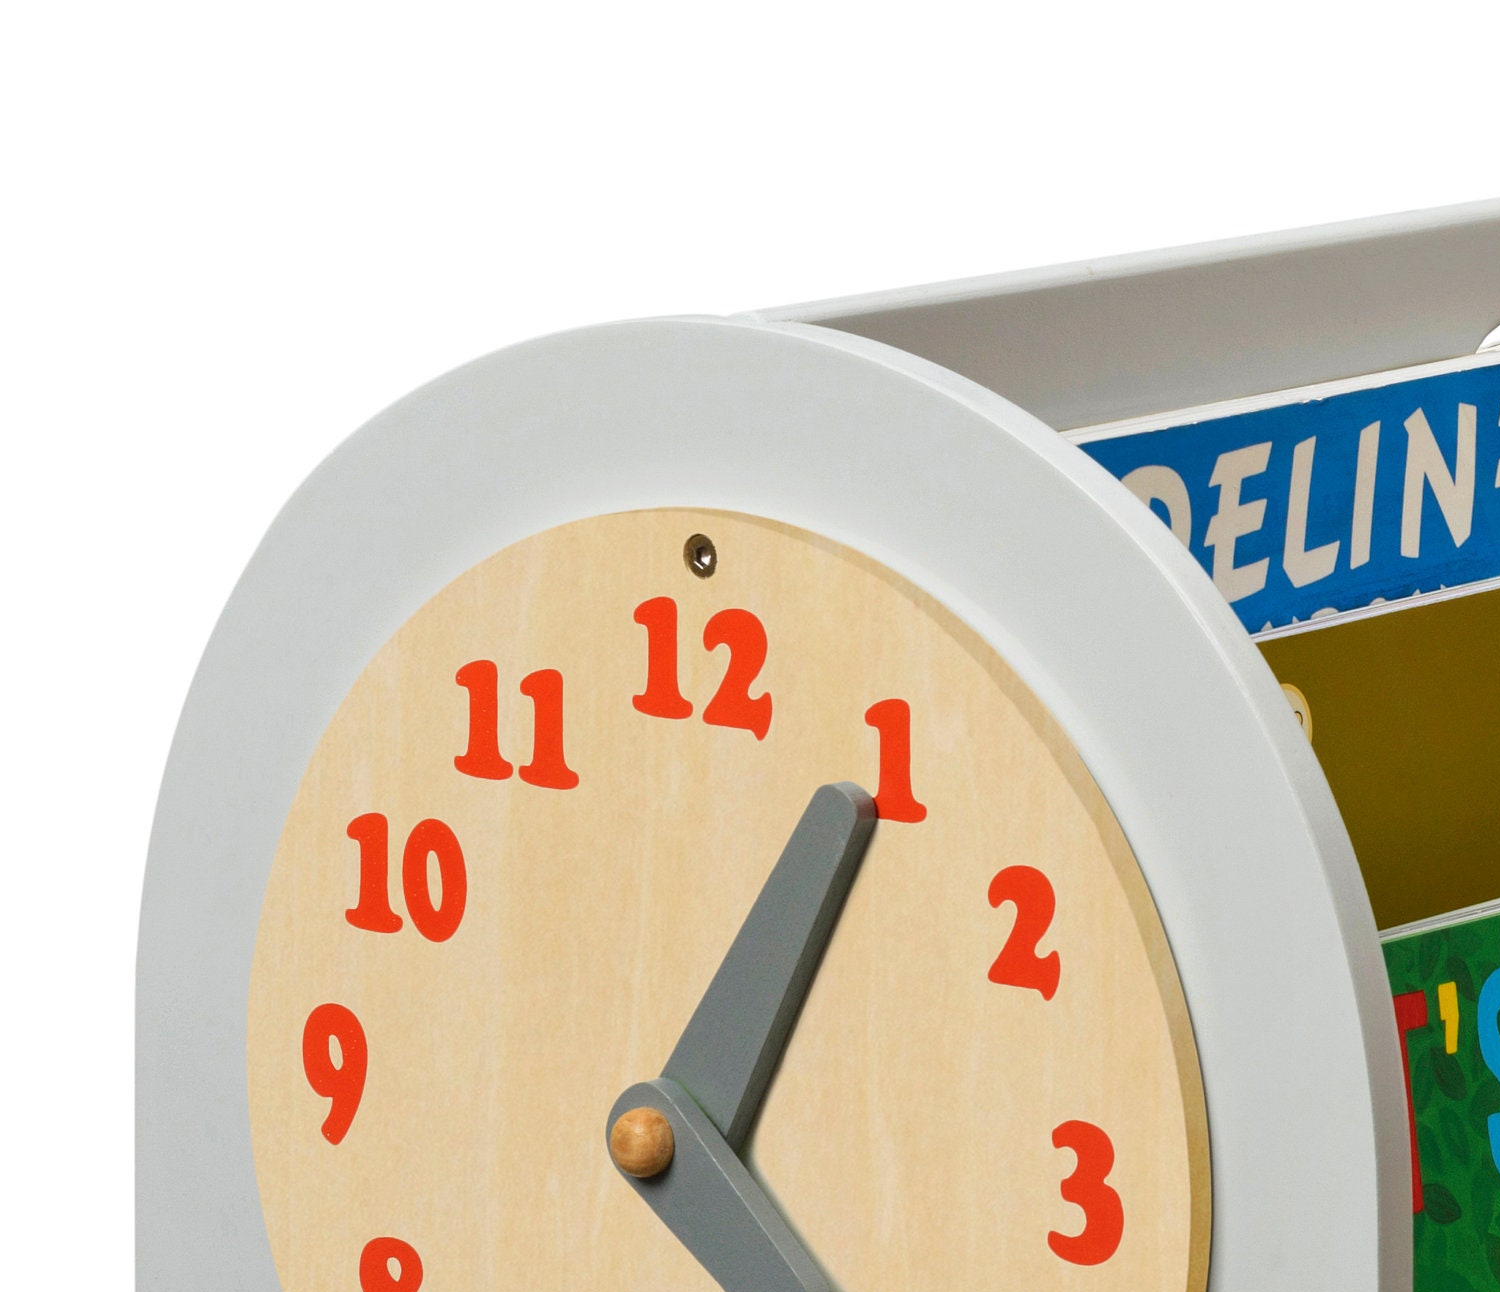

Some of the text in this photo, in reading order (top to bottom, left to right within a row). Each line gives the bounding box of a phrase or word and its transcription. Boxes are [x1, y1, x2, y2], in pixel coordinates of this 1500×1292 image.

[454, 660, 580, 790] 11
[633, 597, 773, 741] 12
[864, 698, 927, 824] 1
[345, 812, 467, 943] 10
[987, 865, 1061, 1001] 2
[302, 1003, 368, 1145] 9
[1047, 1120, 1125, 1266] 3
